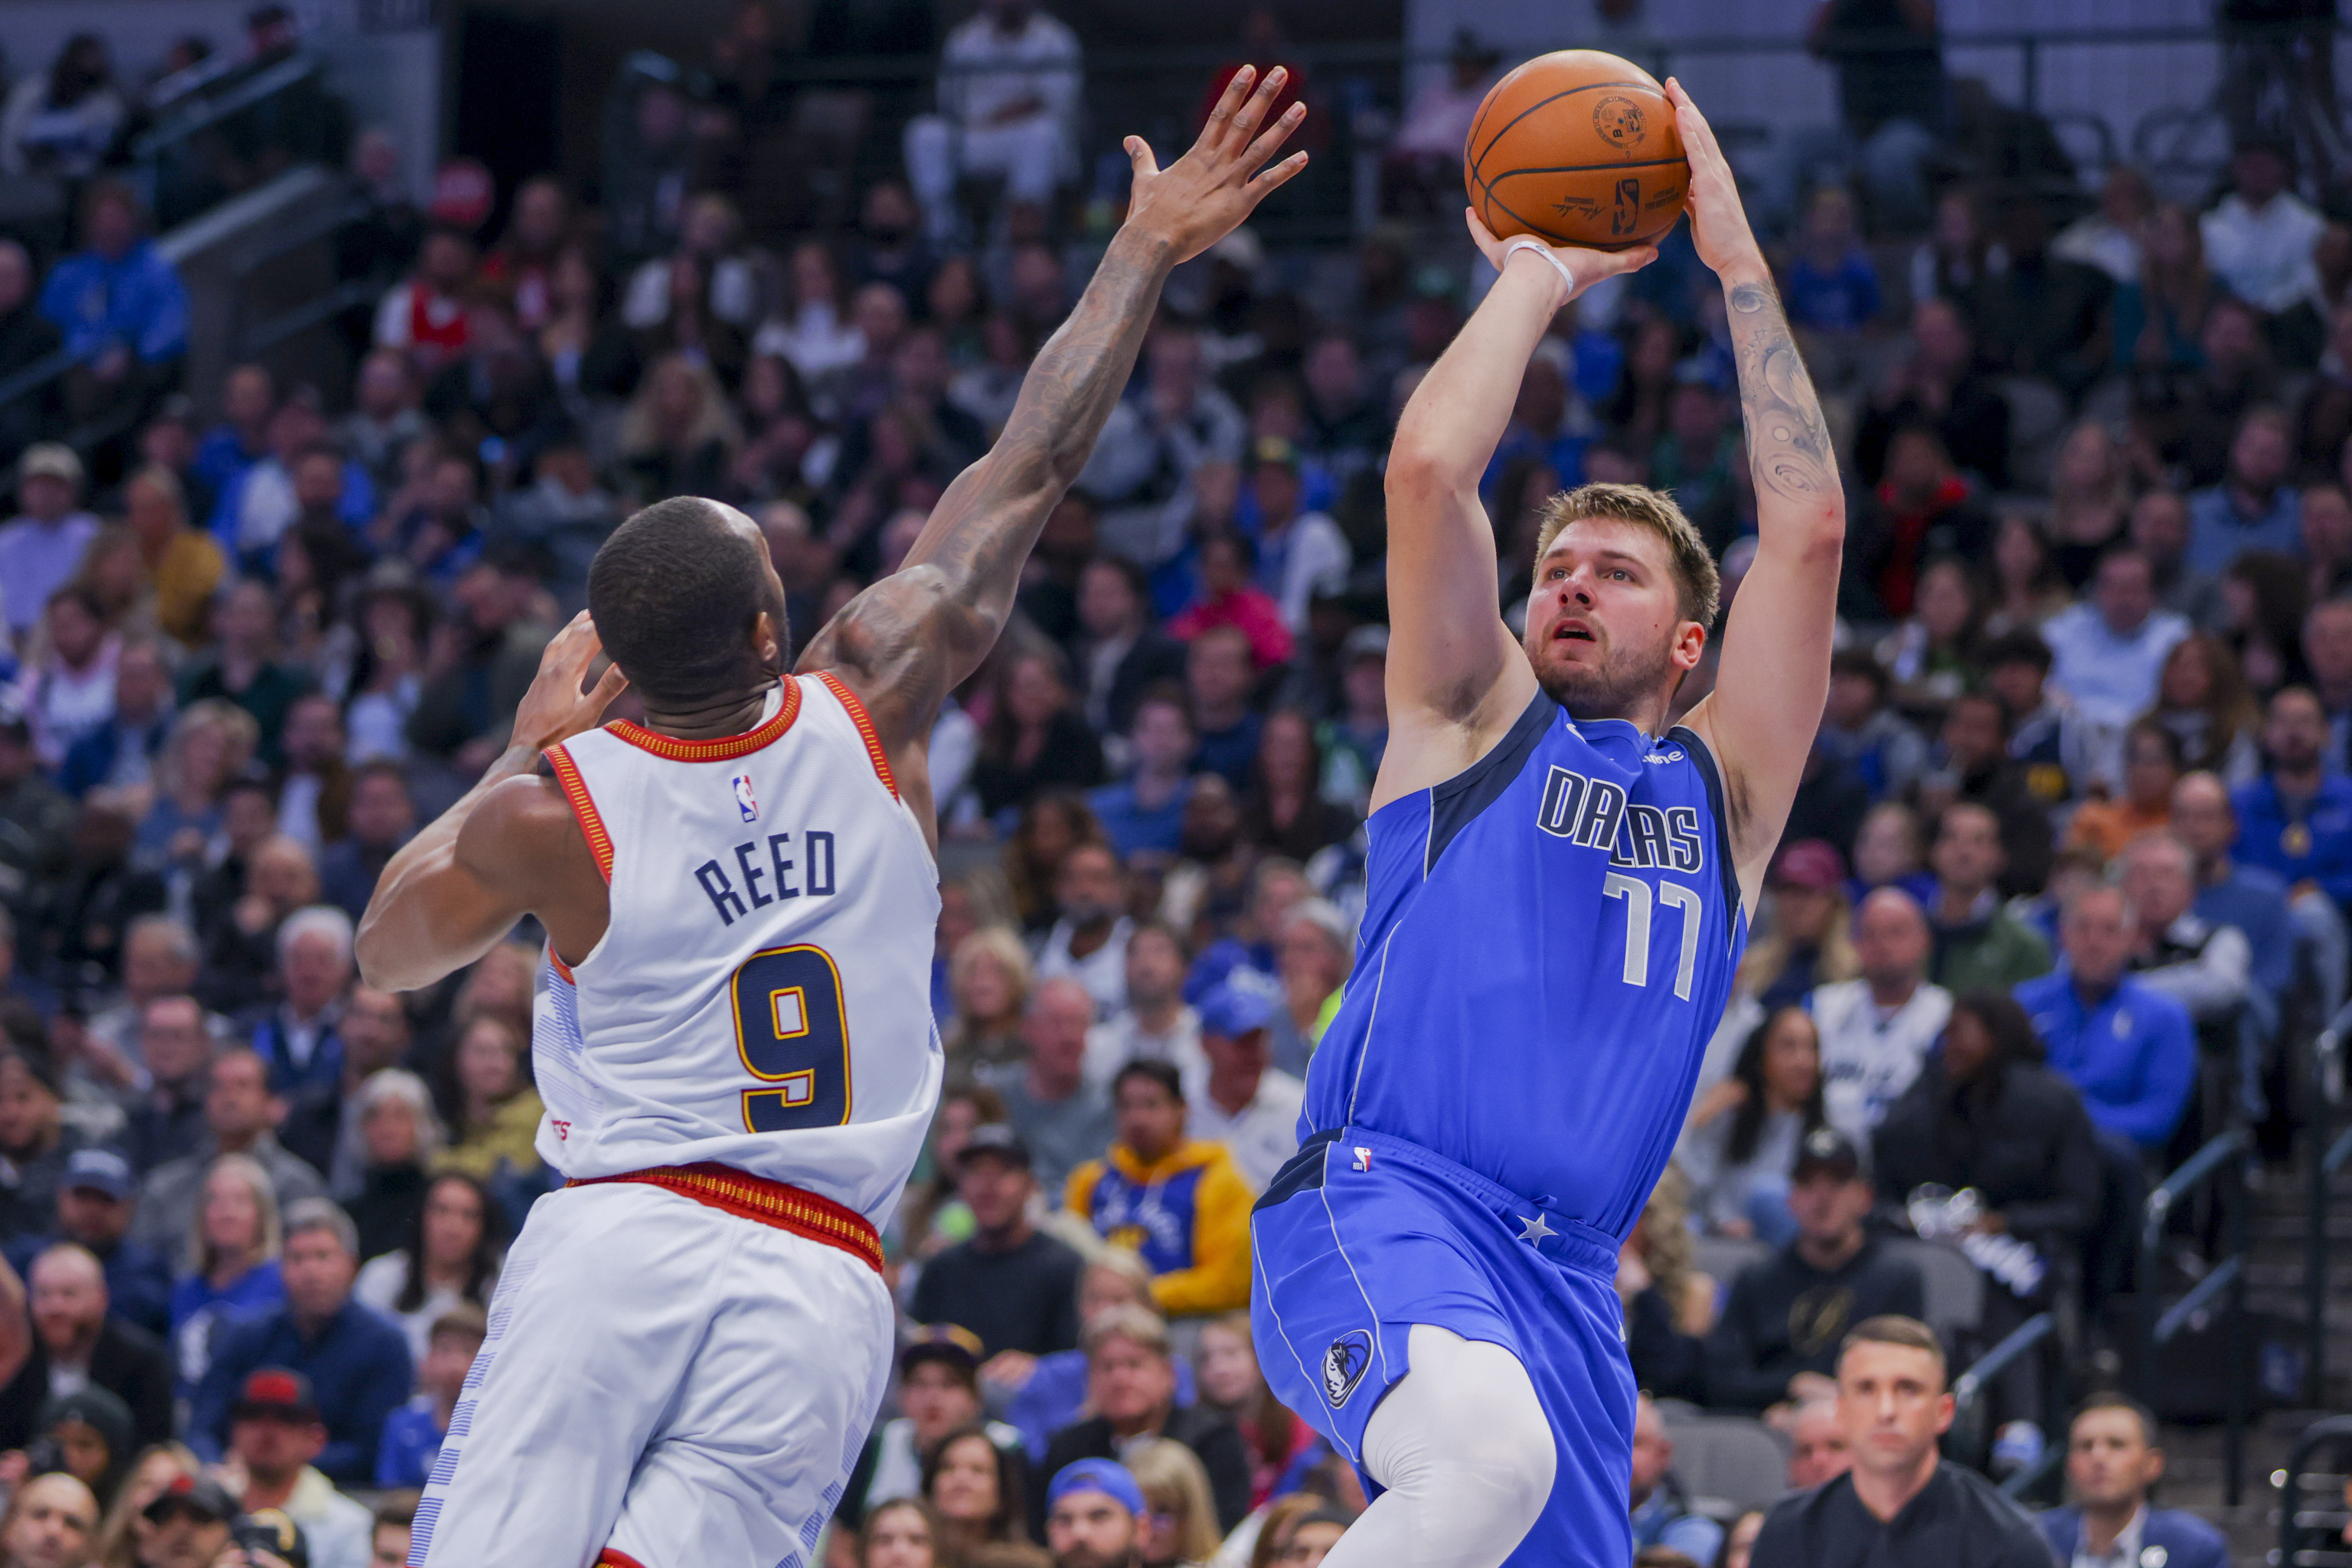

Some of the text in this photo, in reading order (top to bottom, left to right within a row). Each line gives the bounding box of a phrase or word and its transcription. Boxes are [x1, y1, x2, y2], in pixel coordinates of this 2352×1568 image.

[1536, 764, 1704, 874] DALAS
[694, 830, 836, 927] REED
[1602, 871, 1703, 1003] 77
[730, 942, 852, 1134] 9
[1352, 1161, 1363, 1171] NBA
